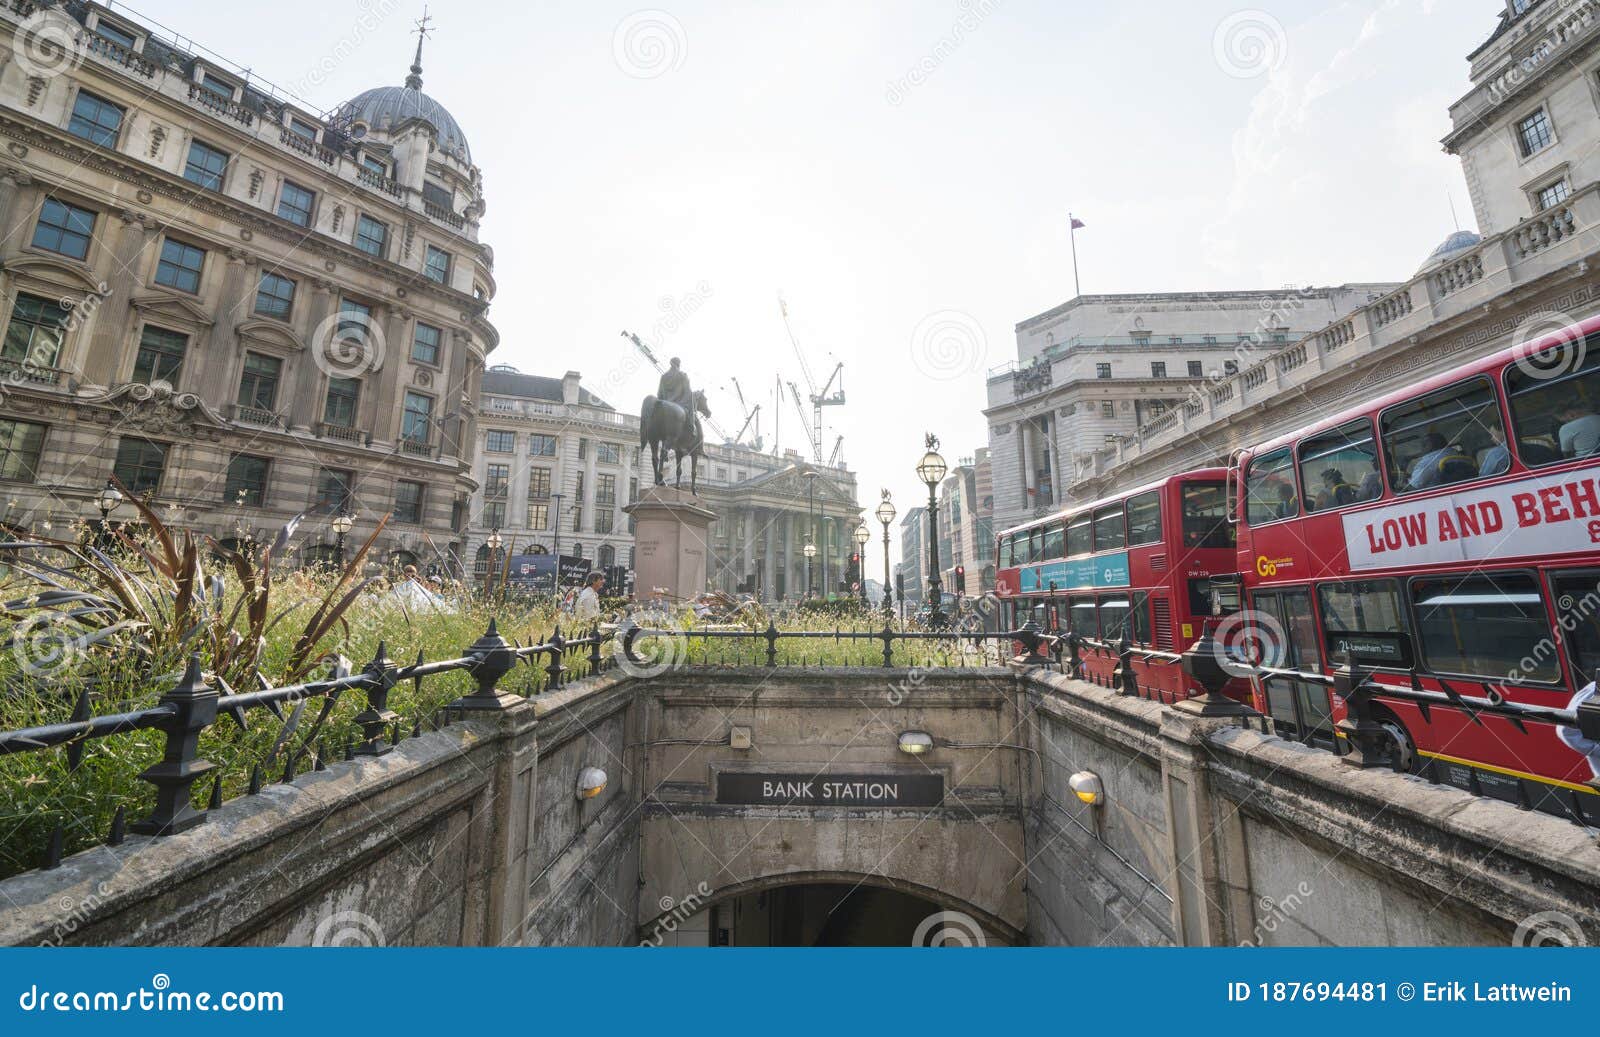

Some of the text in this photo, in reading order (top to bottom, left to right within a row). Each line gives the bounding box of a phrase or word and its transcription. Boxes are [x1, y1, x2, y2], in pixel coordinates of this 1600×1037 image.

[1366, 478, 1600, 554] LOW AND BEH
[763, 781, 898, 799] BANK STATION
